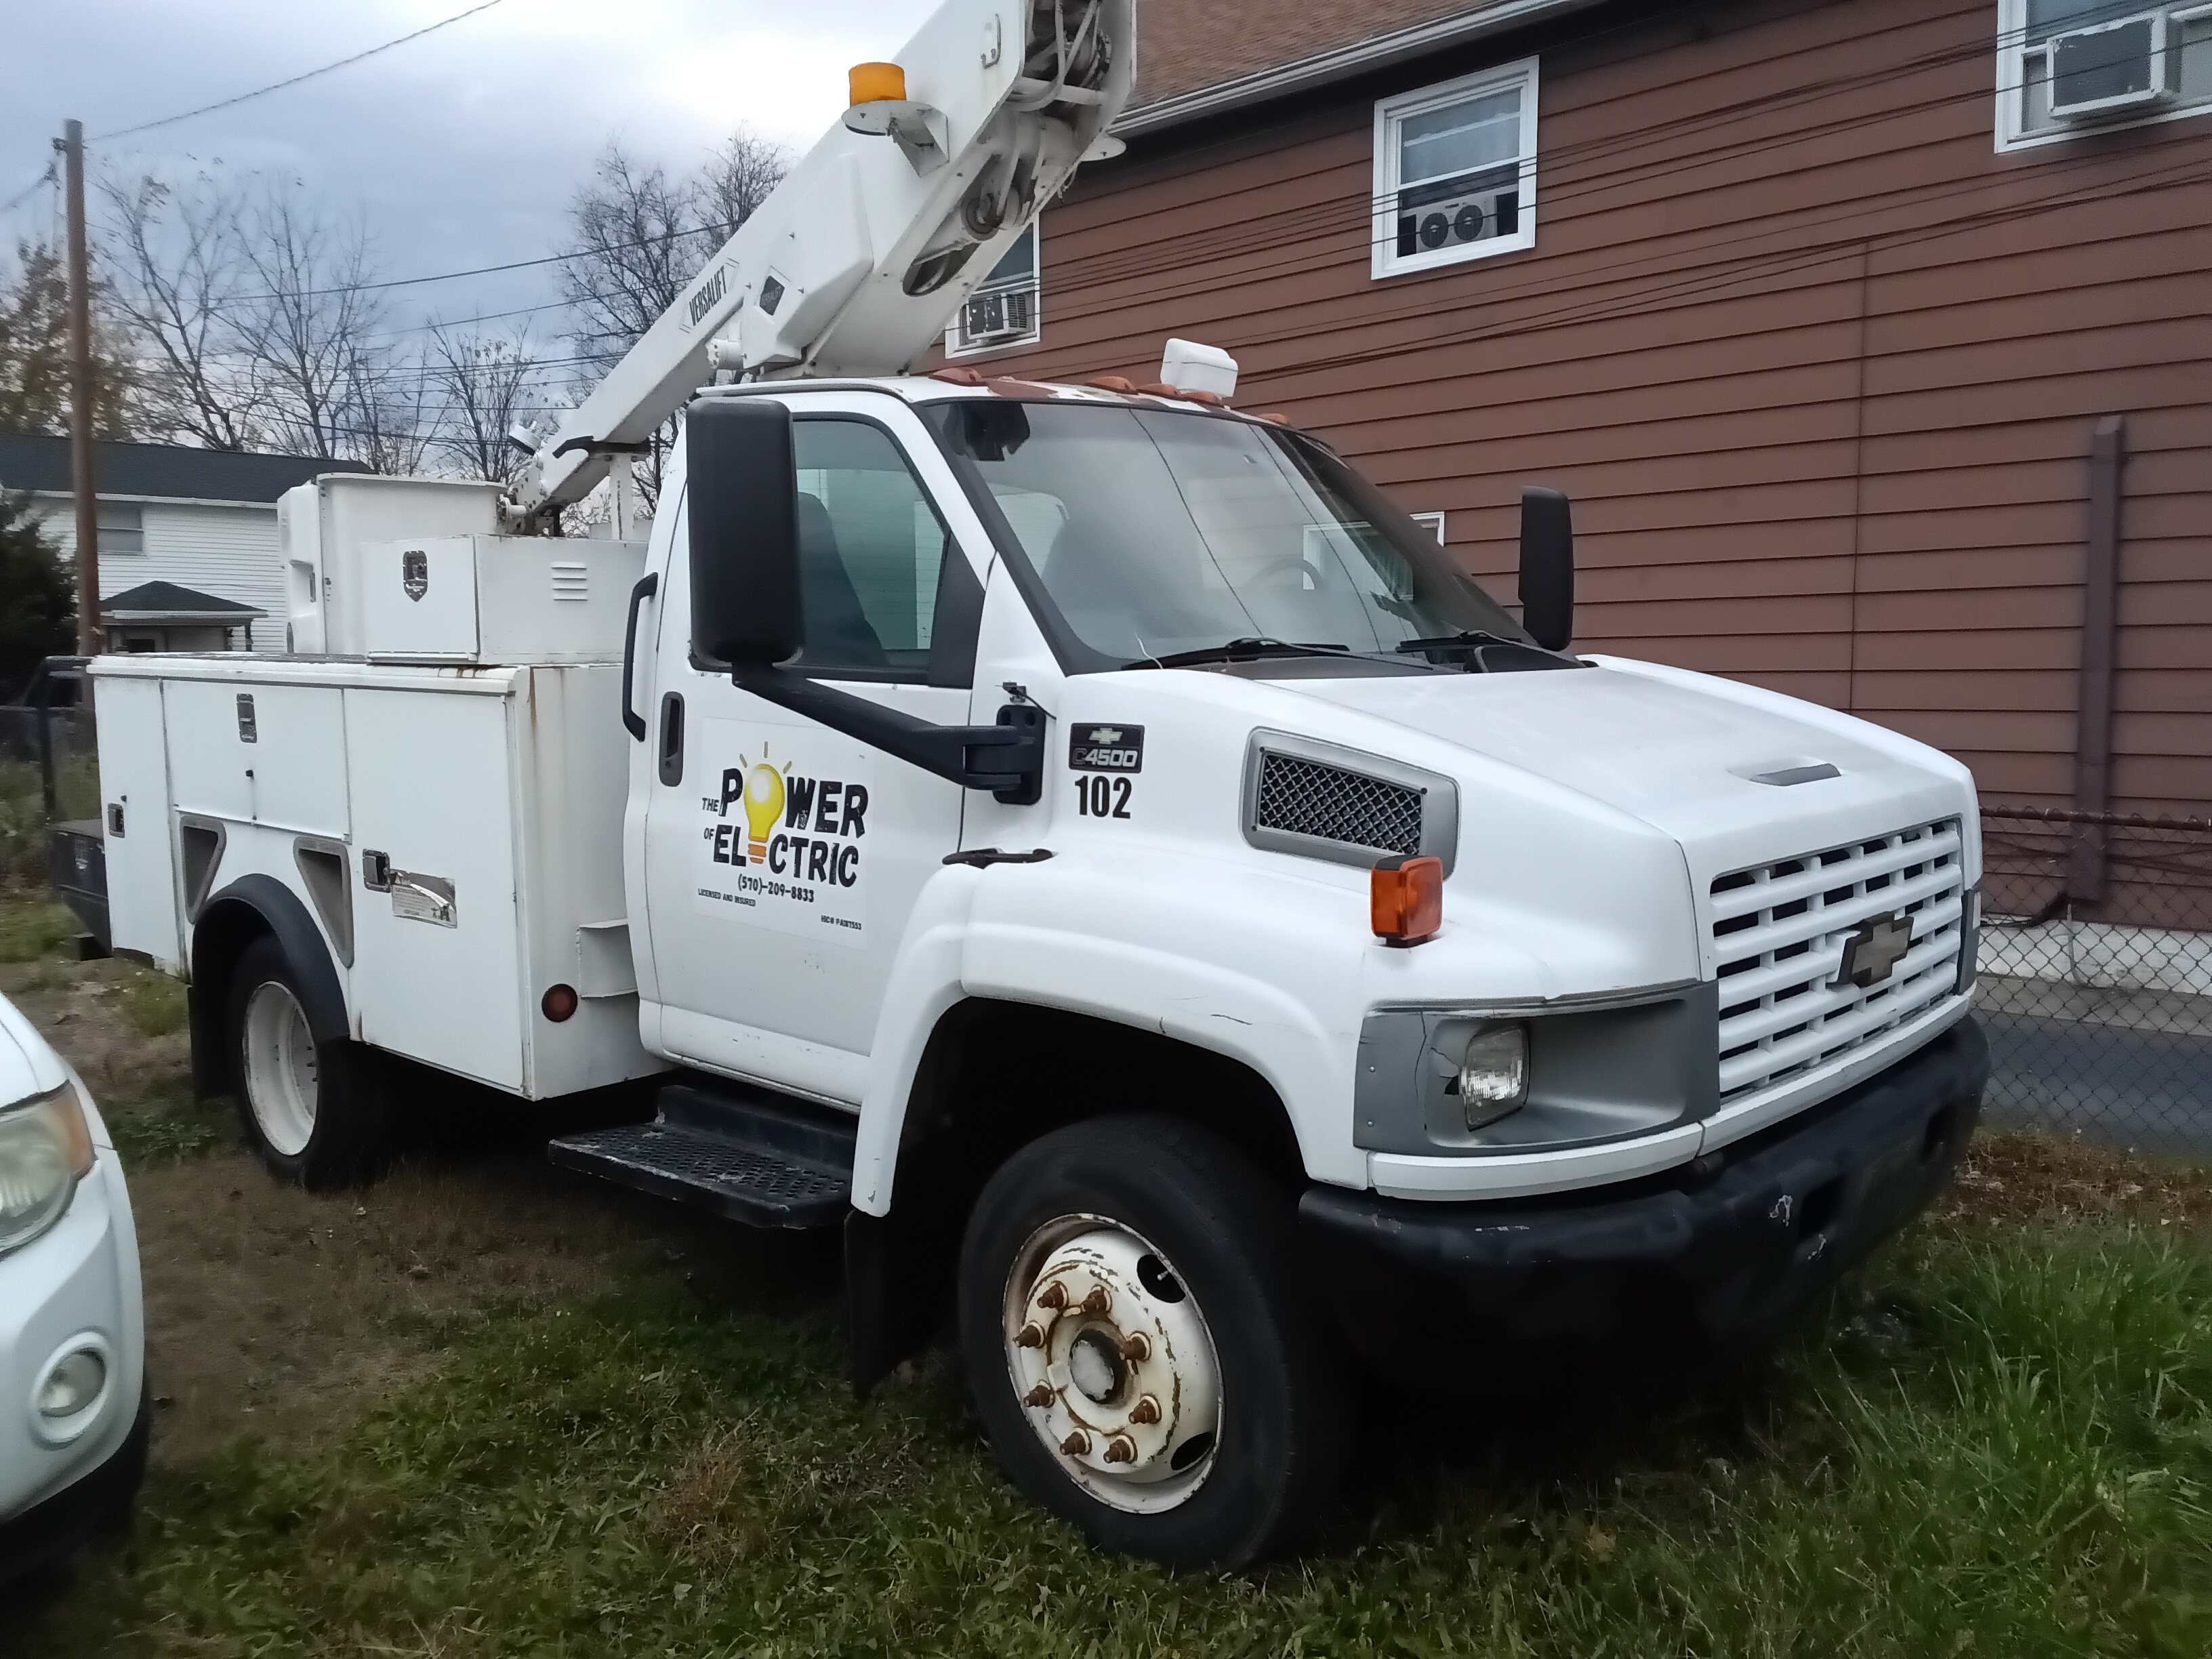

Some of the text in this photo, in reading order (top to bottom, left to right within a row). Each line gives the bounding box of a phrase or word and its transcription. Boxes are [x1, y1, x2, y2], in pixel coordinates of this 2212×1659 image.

[689, 265, 726, 326] VERSALIFT
[1072, 747, 1138, 767] C4500
[702, 798, 719, 812] THE
[1074, 775, 1132, 819] 102
[703, 827, 714, 840] OF
[722, 894, 733, 902] AND
[738, 874, 814, 903] (570)-209-8833
